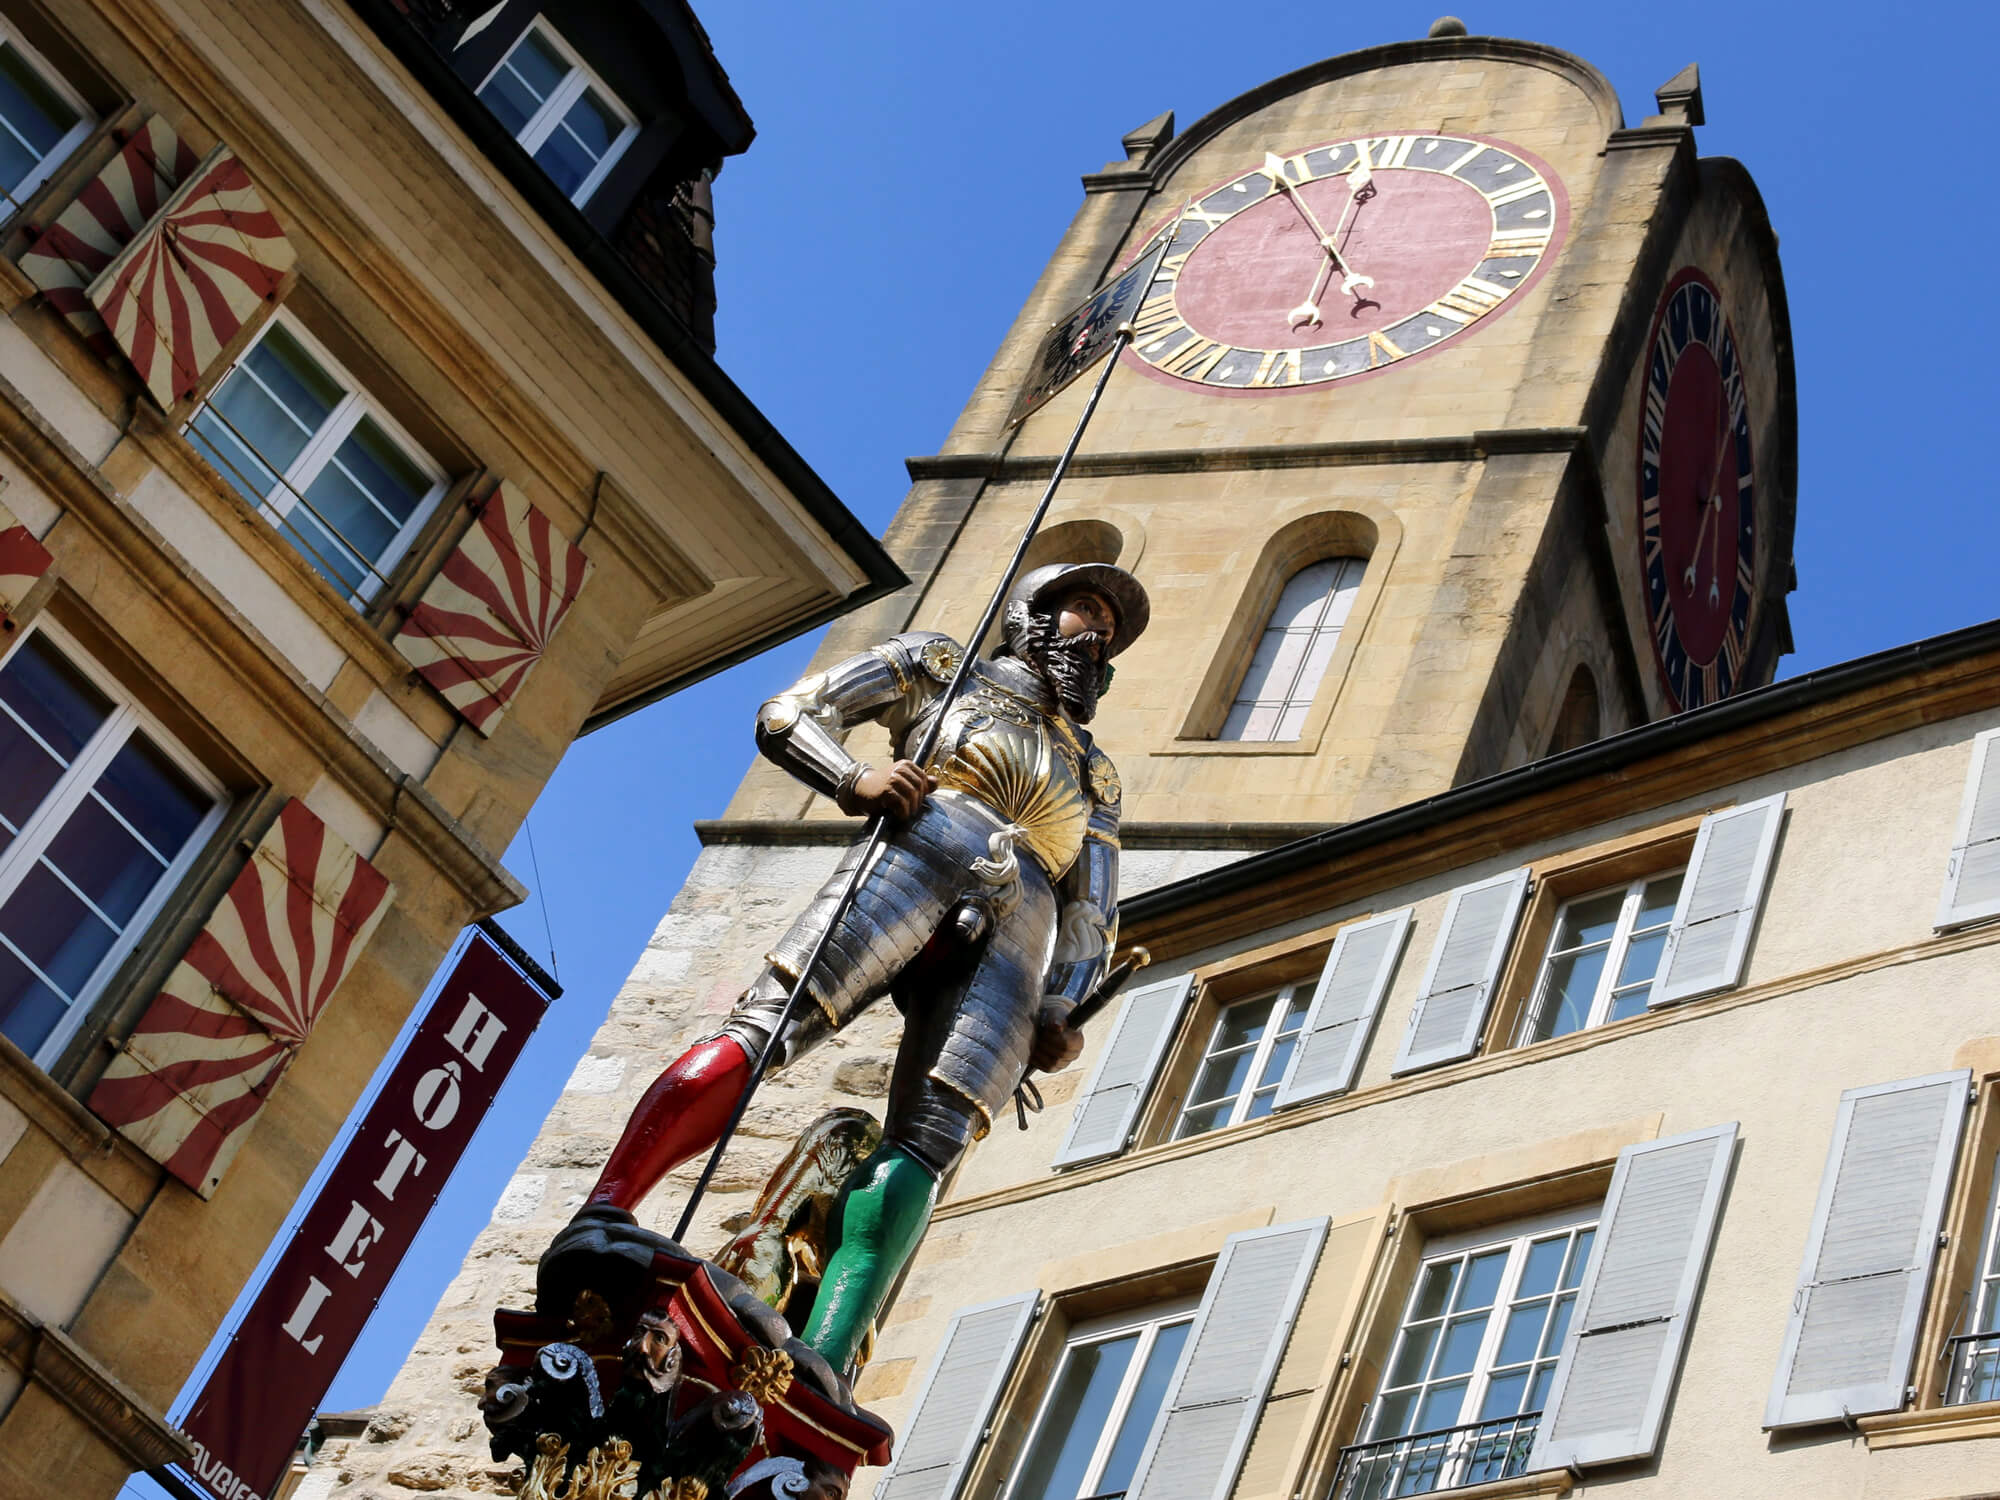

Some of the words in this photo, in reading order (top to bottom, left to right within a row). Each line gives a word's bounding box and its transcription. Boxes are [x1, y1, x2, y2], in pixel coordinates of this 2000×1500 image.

[1486, 173, 1549, 208] II
[1484, 228, 1553, 261] III
[282, 992, 508, 1356] HÔTEL
